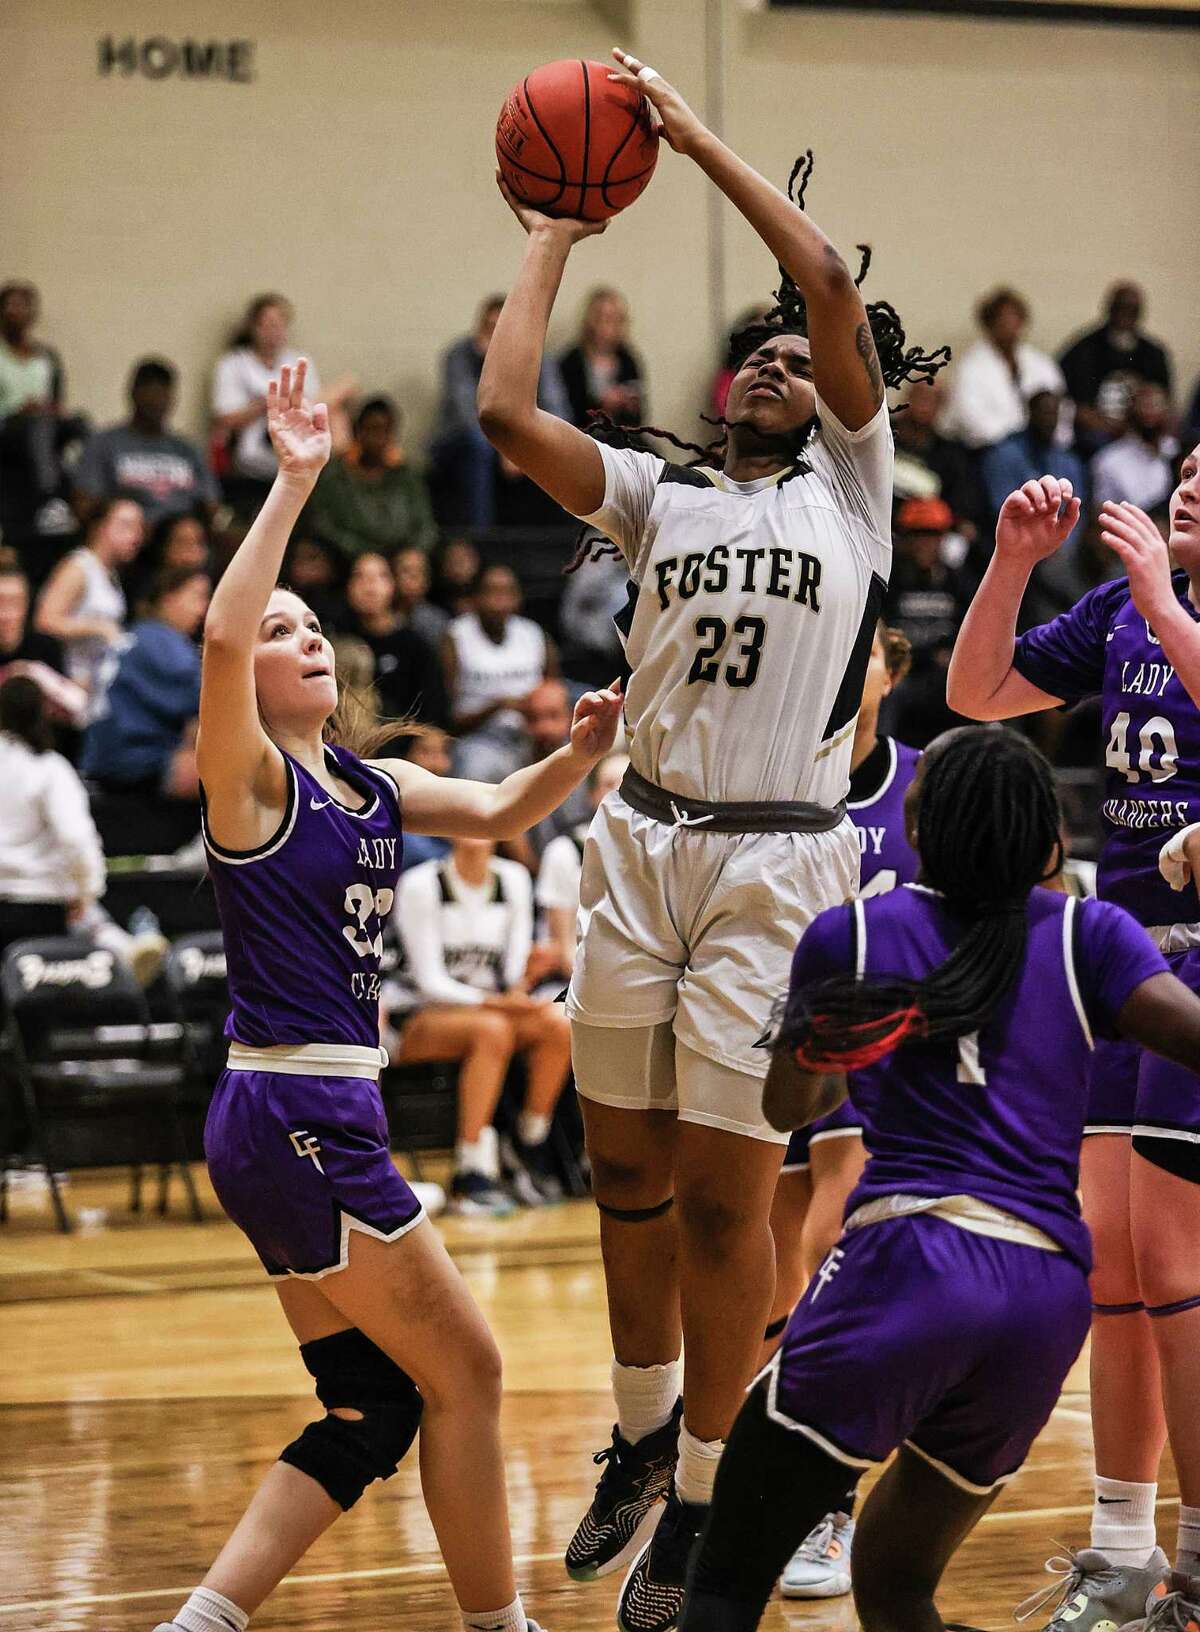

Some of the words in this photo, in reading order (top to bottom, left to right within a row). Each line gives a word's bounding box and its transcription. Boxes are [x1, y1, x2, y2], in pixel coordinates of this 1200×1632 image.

[97, 35, 255, 83] HOME
[655, 544, 823, 615] FOSTER
[686, 614, 769, 690] 23
[1121, 660, 1175, 697] LADY
[1105, 711, 1179, 784] 40
